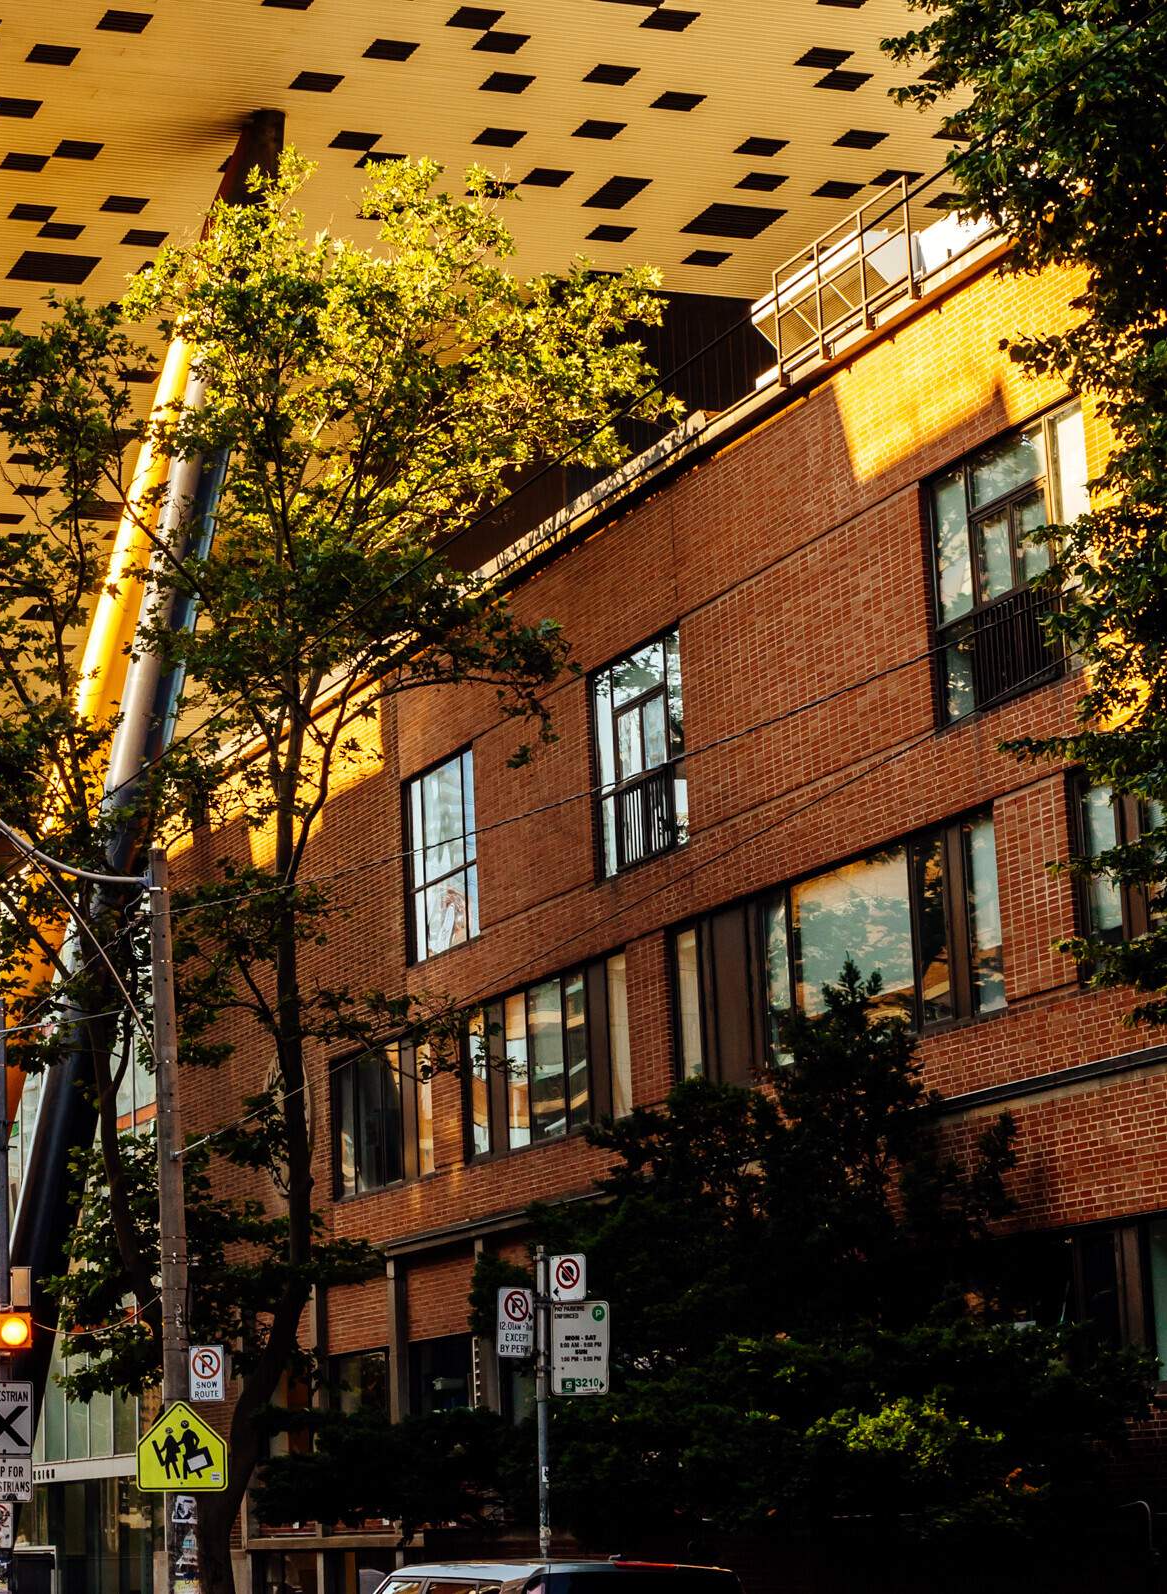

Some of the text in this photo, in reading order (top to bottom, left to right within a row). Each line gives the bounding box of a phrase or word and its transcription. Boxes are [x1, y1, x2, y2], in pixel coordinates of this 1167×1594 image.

[506, 1332, 528, 1342] EXCEPT
[500, 1344, 510, 1352] BY
[576, 1378, 598, 1387] 3210
[8, 1466, 23, 1477] FOR
